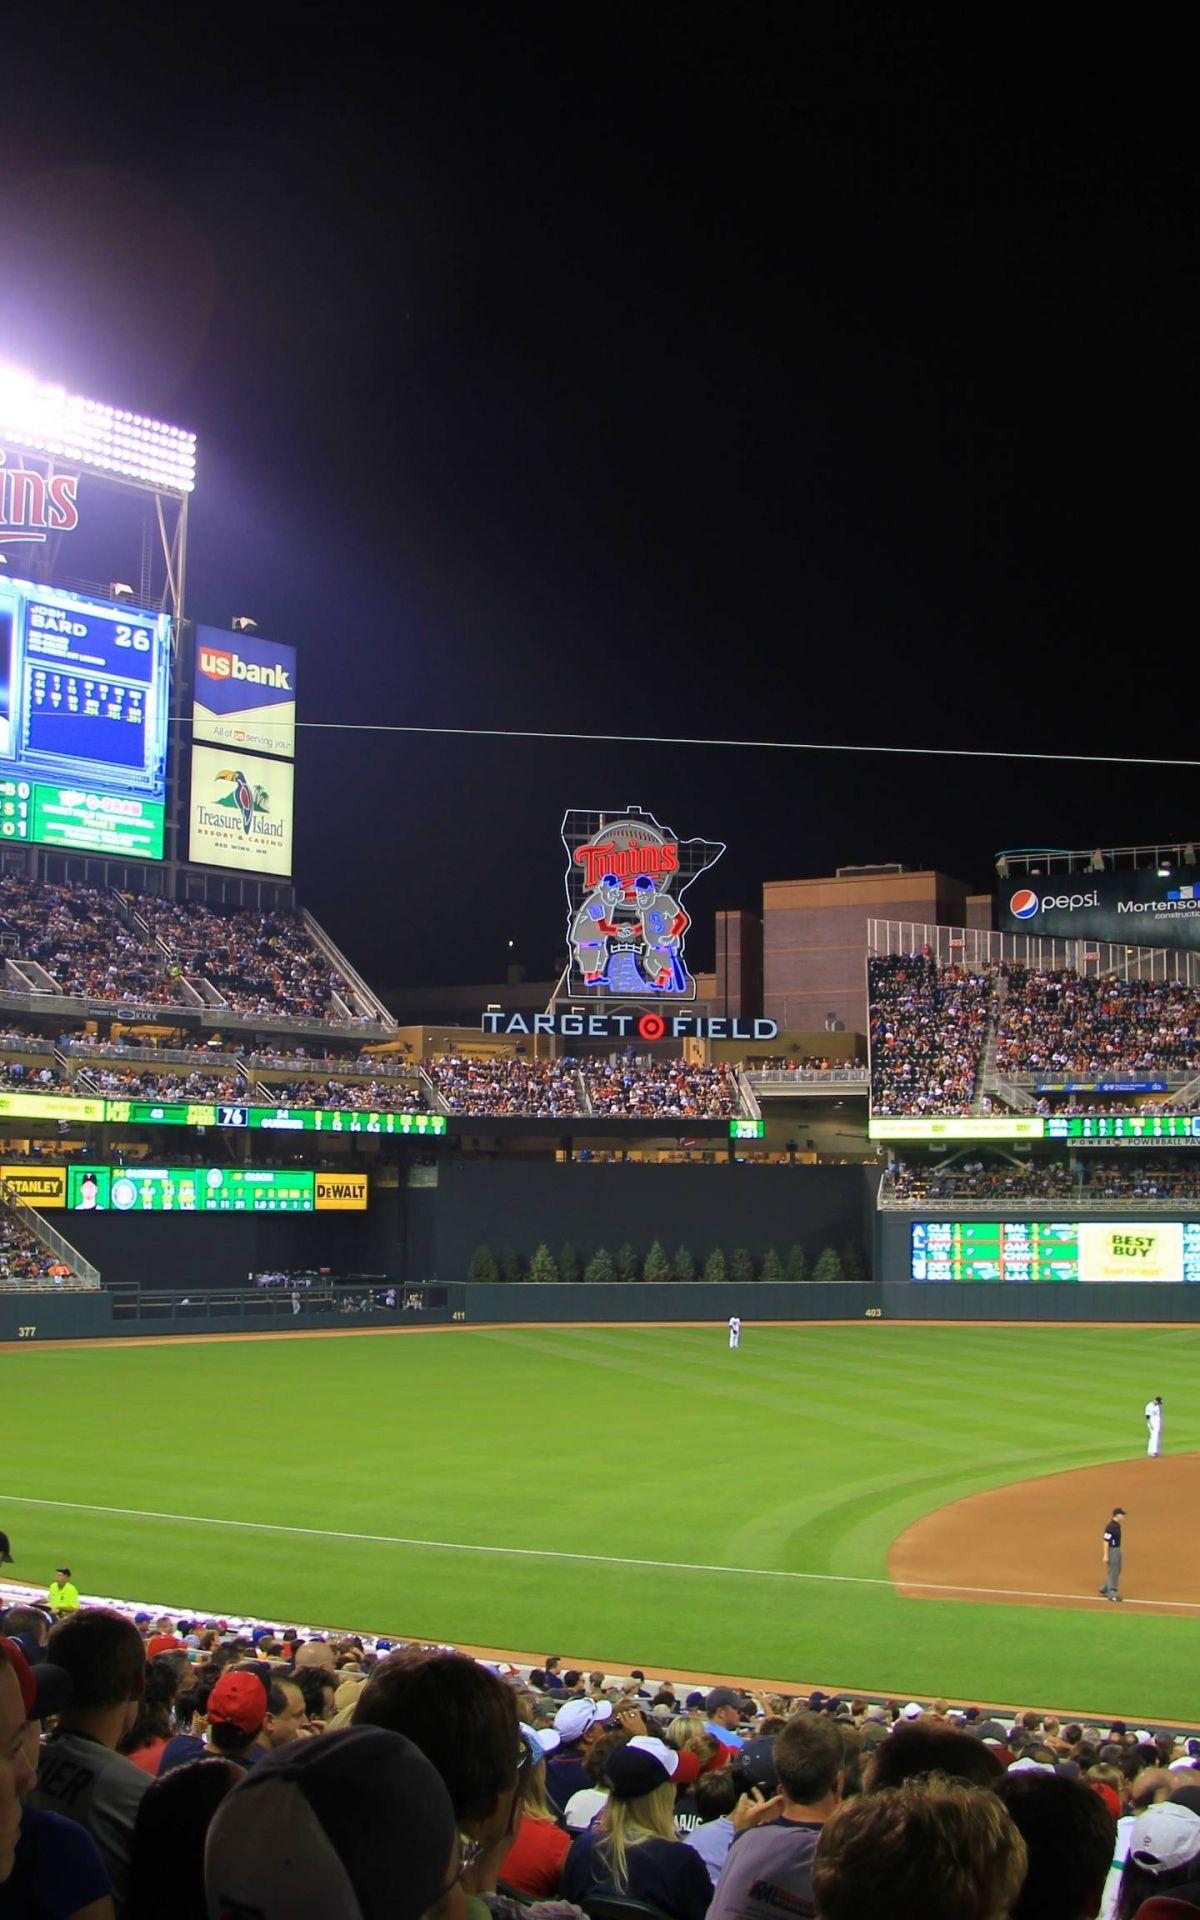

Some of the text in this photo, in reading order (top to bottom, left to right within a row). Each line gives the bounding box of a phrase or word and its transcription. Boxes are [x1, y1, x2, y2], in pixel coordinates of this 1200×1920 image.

[31, 614, 88, 638] BARD
[115, 625, 151, 652] 26
[213, 726, 224, 736] All
[224, 728, 233, 738] of
[246, 733, 273, 749] serving
[18, 782, 30, 800] 0
[18, 802, 28, 819] 1
[17, 820, 27, 838] 1
[197, 805, 283, 837] Treasure Island
[197, 828, 234, 839] RESORT
[248, 836, 283, 847] CASINO
[575, 840, 678, 886] Twins
[1041, 890, 1098, 913] pepsi
[1117, 899, 1200, 914] Mortenso
[484, 1012, 778, 1040] TARGET FIELD
[223, 1108, 243, 1125] 76
[1128, 1138, 1182, 1146] POWERBALL
[7, 1180, 59, 1194] STANLEY
[1112, 1234, 1156, 1247] BEST
[1113, 1246, 1150, 1258] BUY
[865, 1308, 882, 1317] 403
[18, 1326, 37, 1337] 377
